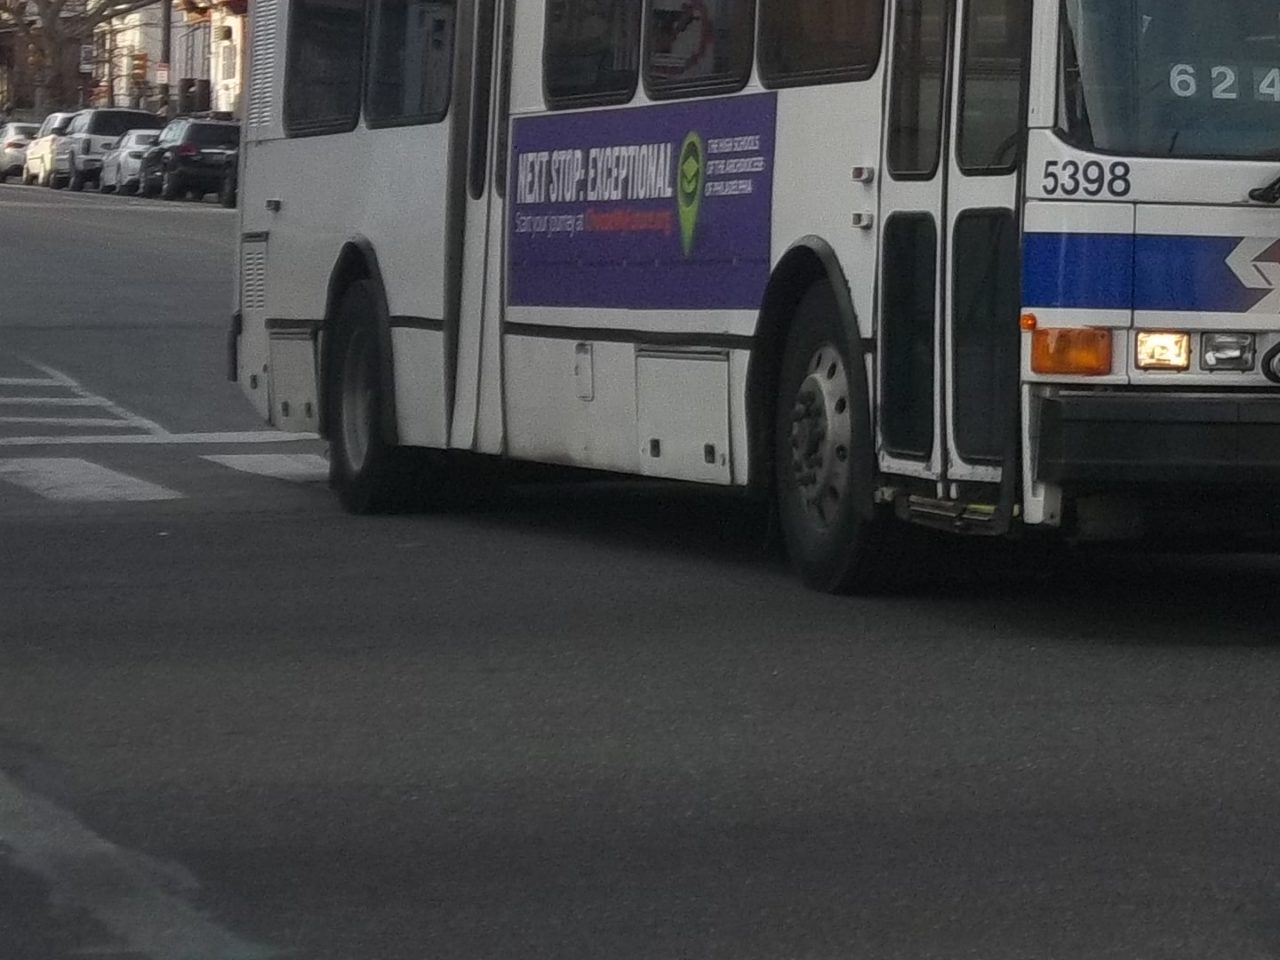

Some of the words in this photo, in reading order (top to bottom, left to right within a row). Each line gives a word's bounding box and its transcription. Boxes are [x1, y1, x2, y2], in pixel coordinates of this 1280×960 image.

[516, 151, 550, 204] NEXT
[550, 149, 586, 203] STOP:
[586, 142, 673, 201] EXCEPTIONAL
[1042, 159, 1131, 197] 5398
